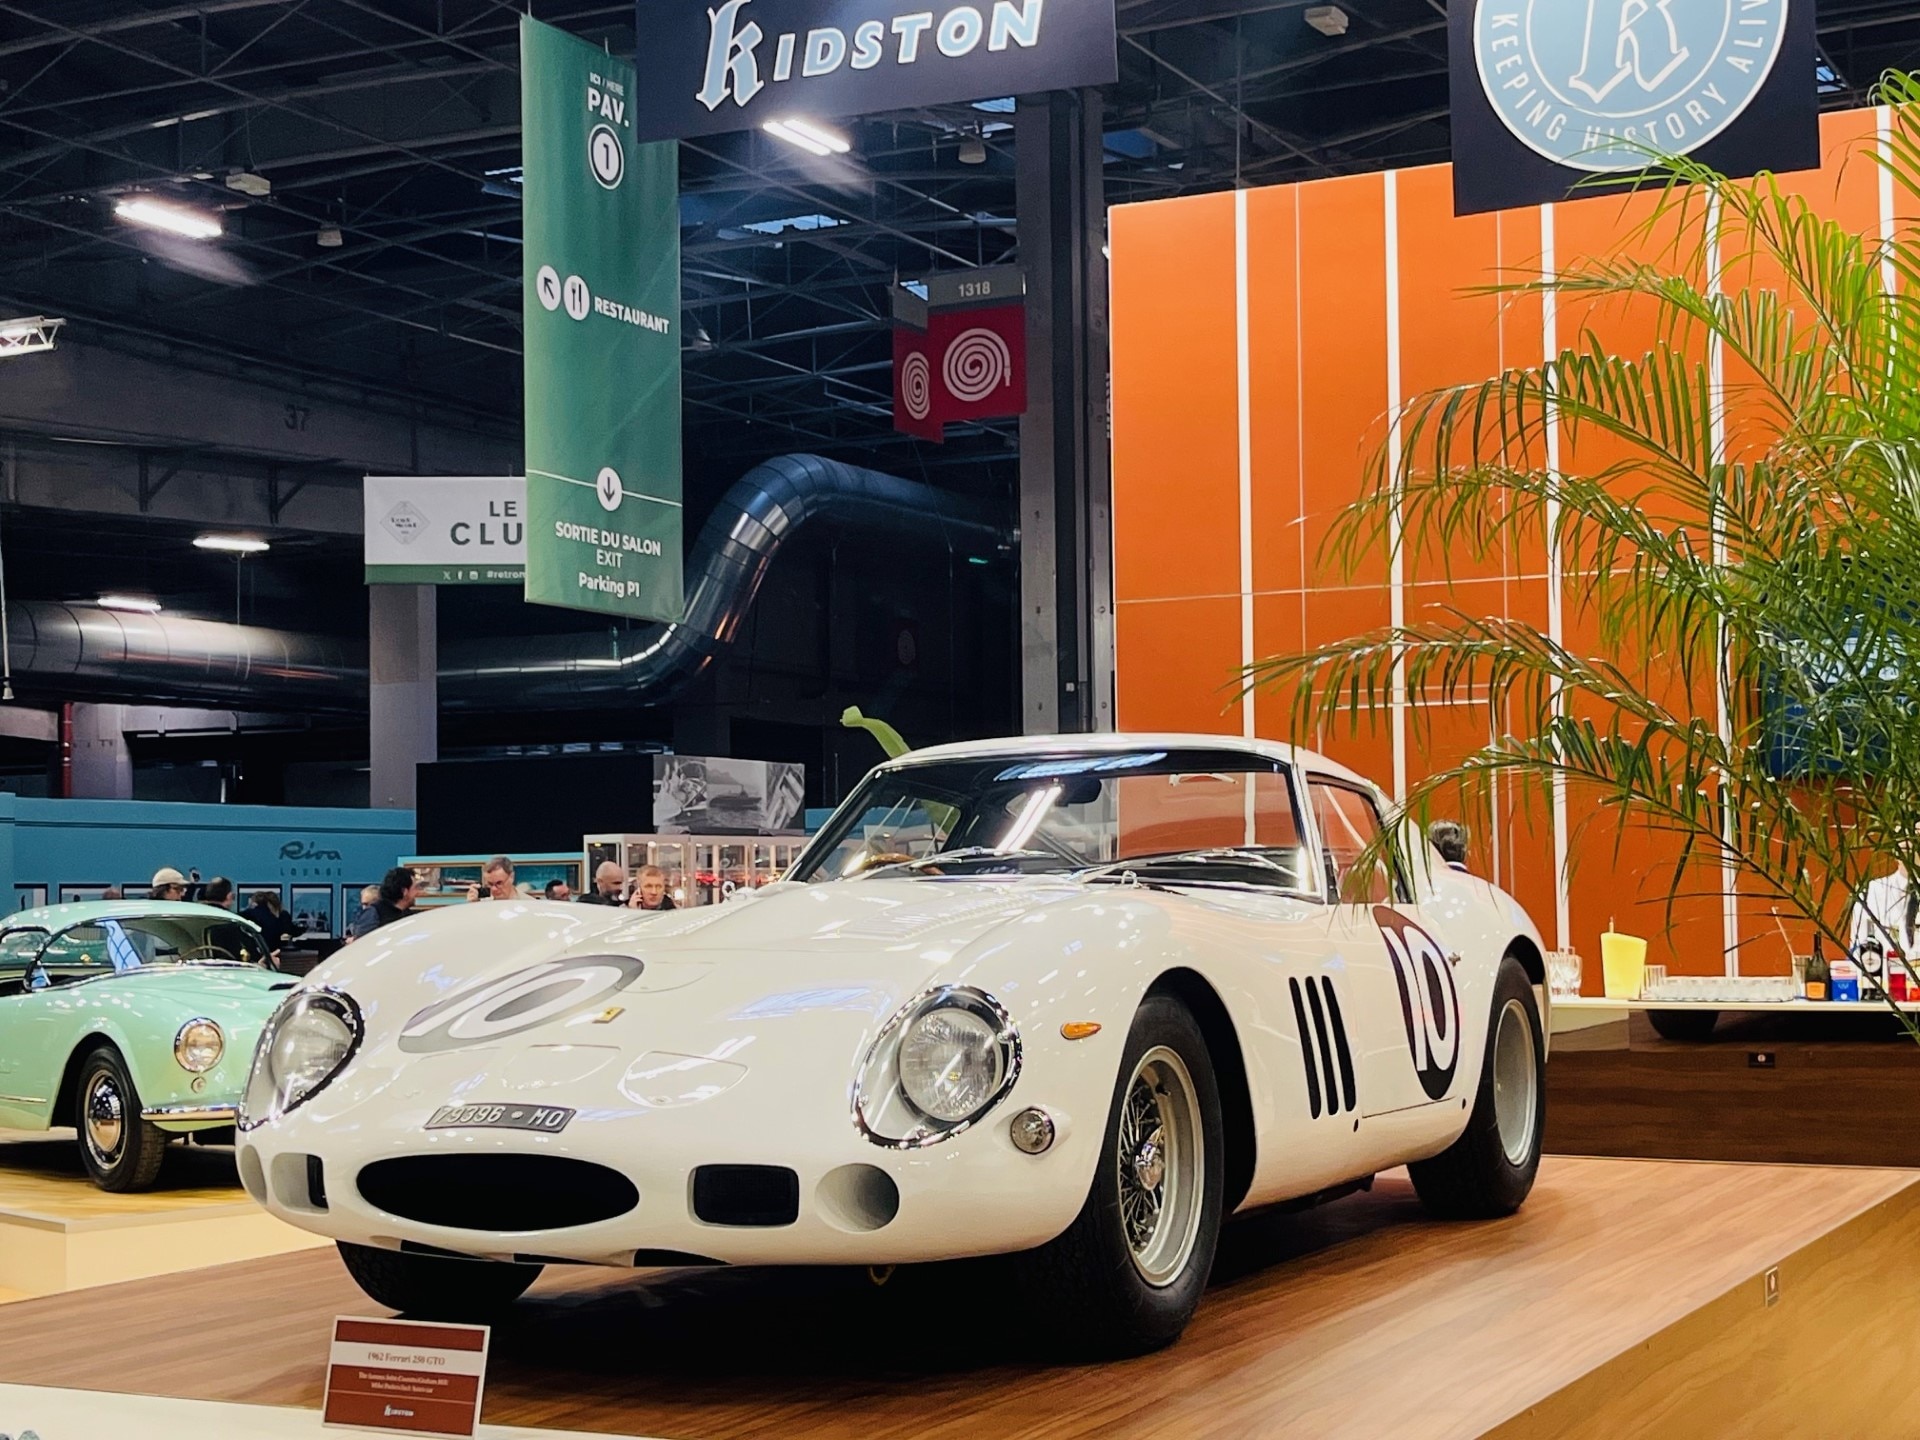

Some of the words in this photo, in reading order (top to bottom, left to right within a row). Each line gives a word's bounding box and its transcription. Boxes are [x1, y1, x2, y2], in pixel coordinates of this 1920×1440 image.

[1491, 13, 1567, 142] KEEPING
[1582, 82, 1727, 155] HISTORY
[587, 86, 630, 127] PAV.
[958, 281, 991, 297] 1318
[594, 296, 670, 335] RESTAURANT
[489, 501, 518, 517] LE
[555, 521, 599, 545] SORTIE
[601, 530, 620, 548] DU
[622, 534, 661, 557] SALON
[596, 549, 623, 568] EXIT
[578, 572, 625, 598] Parking
[627, 581, 640, 598] P1
[399, 962, 624, 1040] 10
[1379, 925, 1456, 1072] 10
[432, 1105, 506, 1124] 79396
[527, 1108, 565, 1128] MO
